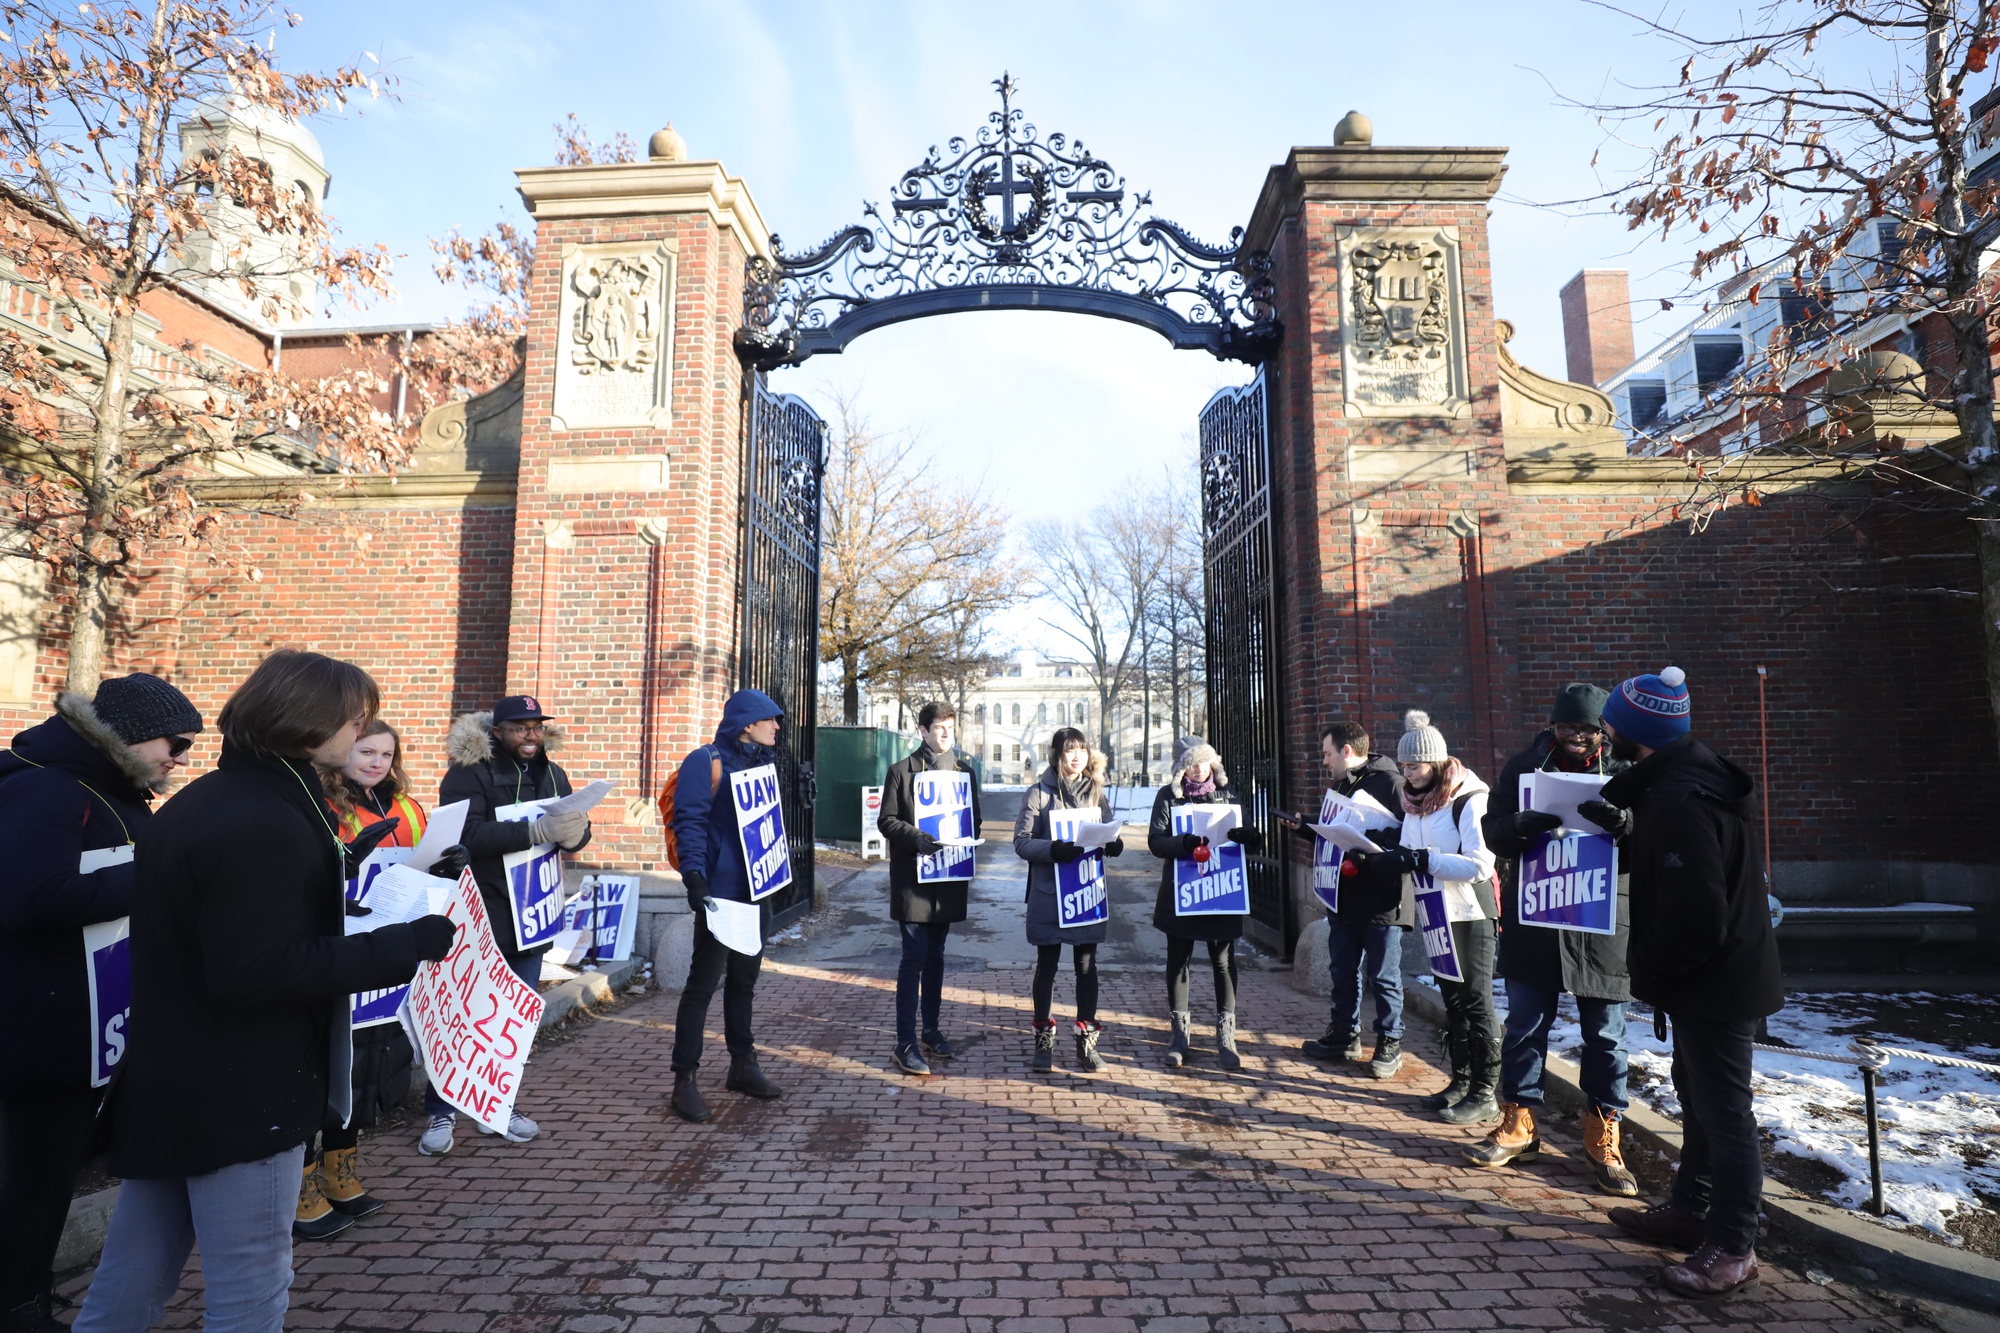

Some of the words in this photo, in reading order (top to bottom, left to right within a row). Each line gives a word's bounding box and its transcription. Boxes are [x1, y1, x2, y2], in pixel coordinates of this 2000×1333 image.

[1366, 371, 1439, 381] ACADEMIAE
[1375, 360, 1429, 370] SIGILLVM
[1359, 381, 1450, 392] HARVARDIANAE
[1633, 693, 1690, 713] DODGE
[735, 774, 777, 812] UAW
[918, 781, 968, 806] UAW
[1321, 799, 1344, 825] UA
[759, 814, 776, 849] ON
[752, 833, 787, 890] STRIKE
[923, 845, 972, 875] STRIKE
[1321, 840, 1335, 863] ON
[1546, 836, 1579, 872] ON
[539, 854, 558, 893] ON
[1078, 855, 1097, 885] ON
[1314, 865, 1338, 889] STRIKE
[1181, 867, 1242, 908] STRIKE
[1524, 867, 1607, 915] STRIKE
[458, 868, 485, 932] THANK
[478, 921, 494, 960] YOU
[486, 949, 543, 1022] TEAMSTERS
[426, 959, 441, 989] OR
[473, 992, 523, 1060] 25
[412, 972, 430, 1025] OUR
[422, 1010, 453, 1078] PICKET
[443, 1066, 502, 1123] LINE
